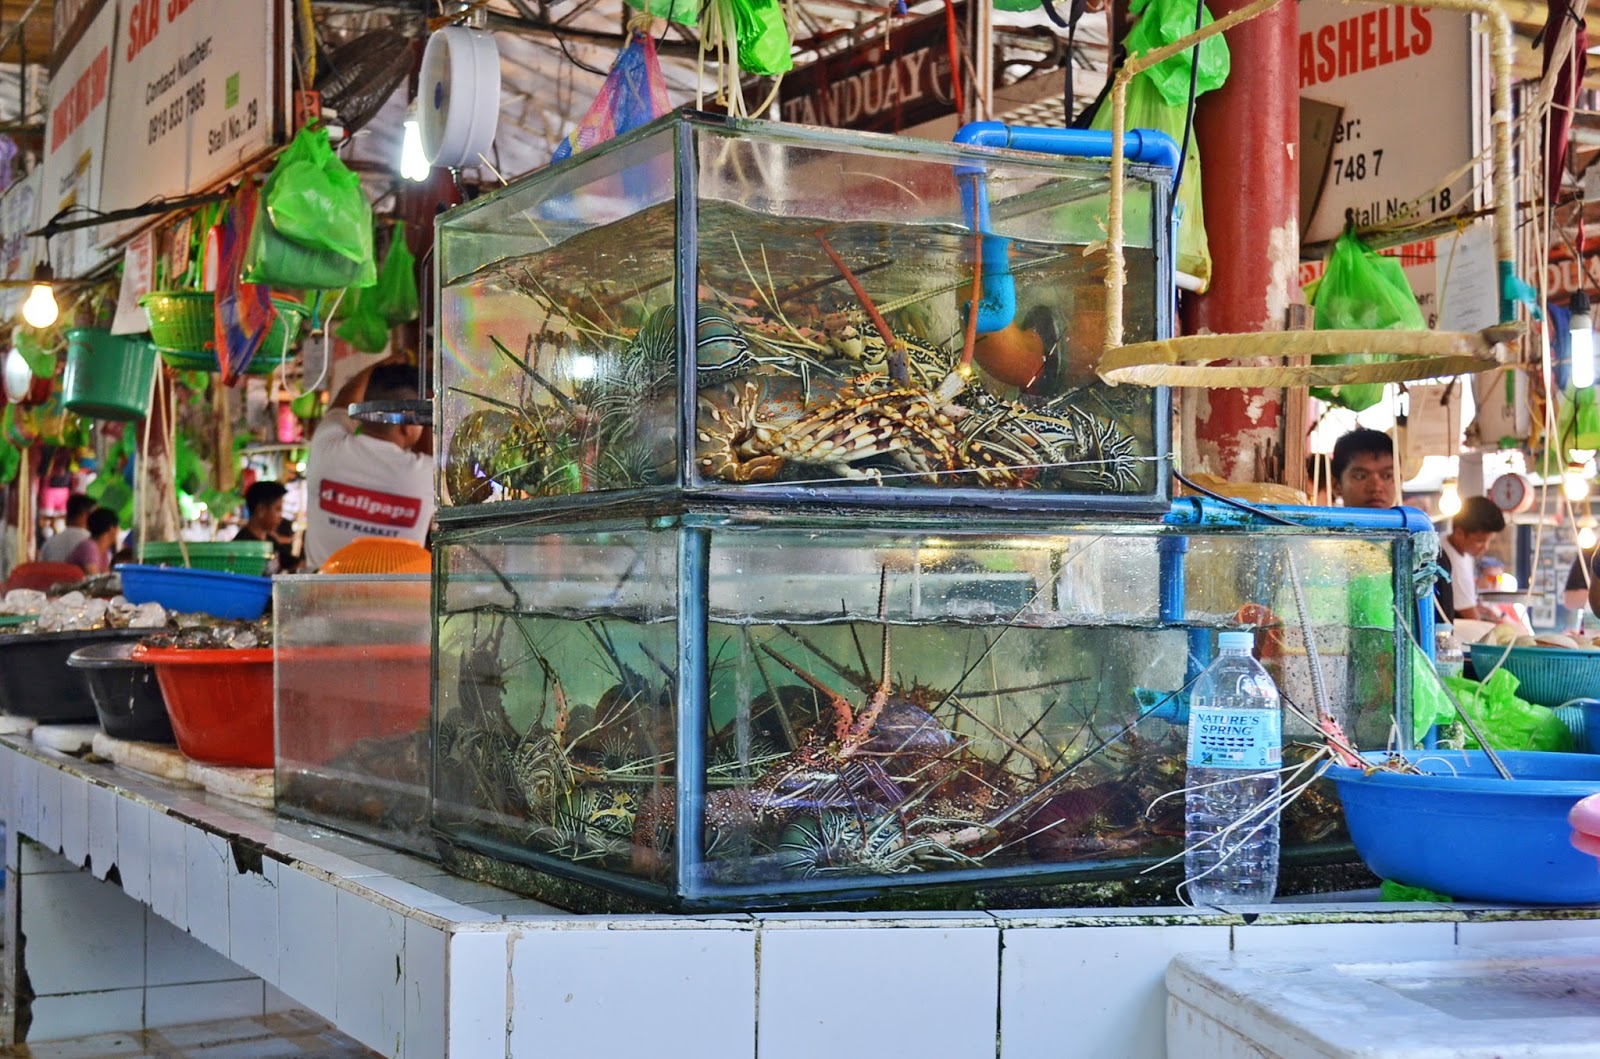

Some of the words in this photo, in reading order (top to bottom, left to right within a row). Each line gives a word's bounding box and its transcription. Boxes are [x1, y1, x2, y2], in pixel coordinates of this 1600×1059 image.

[784, 47, 930, 127] TANDUAY
[208, 119, 226, 156] Stall
[248, 98, 258, 131] 29
[1429, 187, 1451, 213] 18
[337, 493, 416, 518] talipapa
[328, 518, 350, 531] WET
[353, 523, 400, 538] MARKET
[1198, 713, 1260, 726] NATURE'S
[1202, 724, 1253, 736] SPRING
